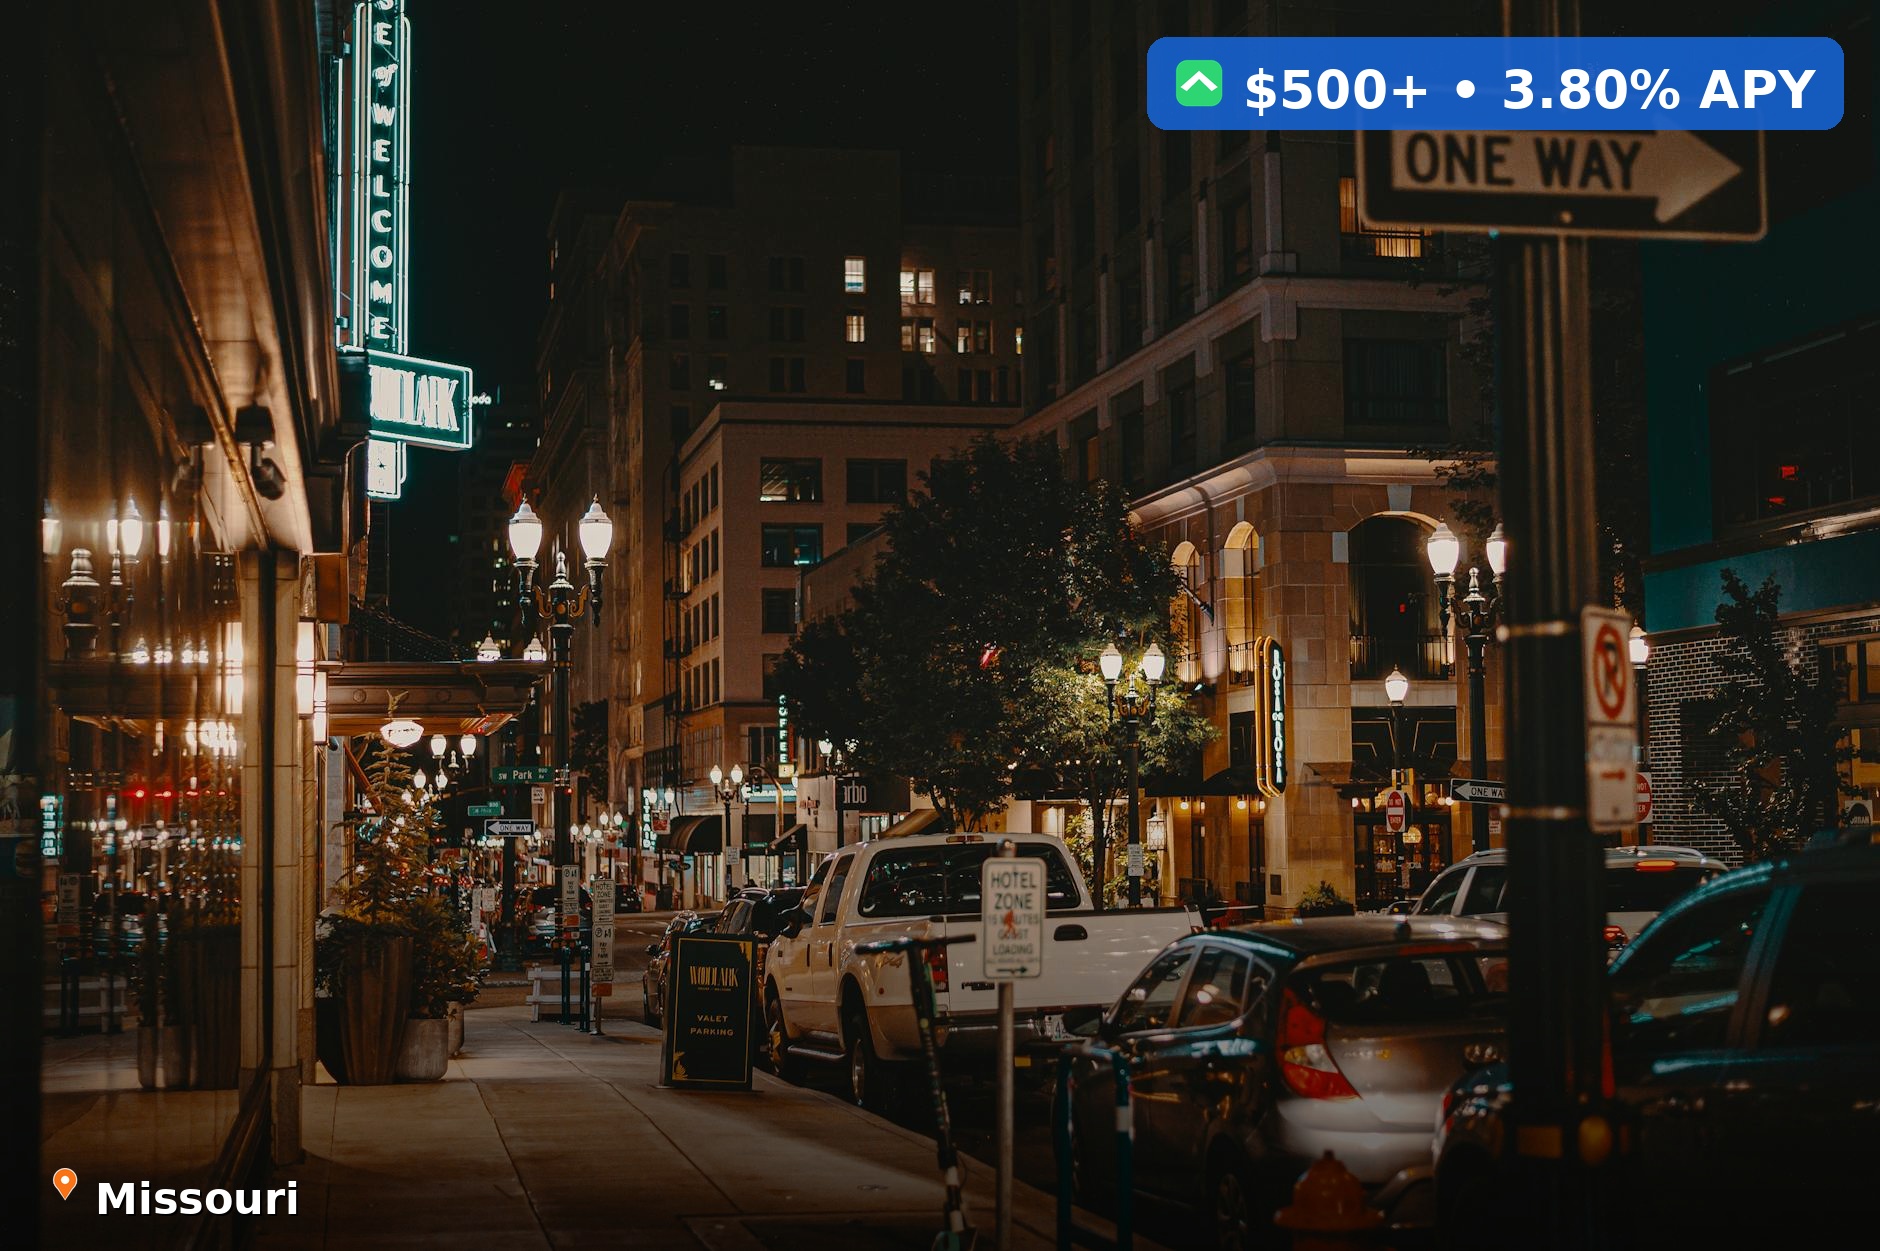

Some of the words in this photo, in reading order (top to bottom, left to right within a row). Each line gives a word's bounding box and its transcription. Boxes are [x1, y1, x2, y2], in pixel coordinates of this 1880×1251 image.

[1406, 133, 1514, 186] ONE
[1536, 138, 1644, 191] WAY
[370, 103, 396, 339] WELCOME
[778, 694, 788, 763] COFFEE
[498, 772, 507, 780] SW
[512, 770, 533, 780] Park
[1471, 787, 1488, 796] ONE
[1491, 788, 1504, 798] WA
[500, 824, 513, 832] ONE
[516, 824, 529, 832] WAY
[991, 871, 1037, 888] HOTEL
[596, 882, 613, 890] HOTEL
[995, 893, 1032, 909] ZONE
[992, 943, 1033, 955] LOADING
[697, 1014, 728, 1022] VALET
[690, 1027, 734, 1036] PARKING
